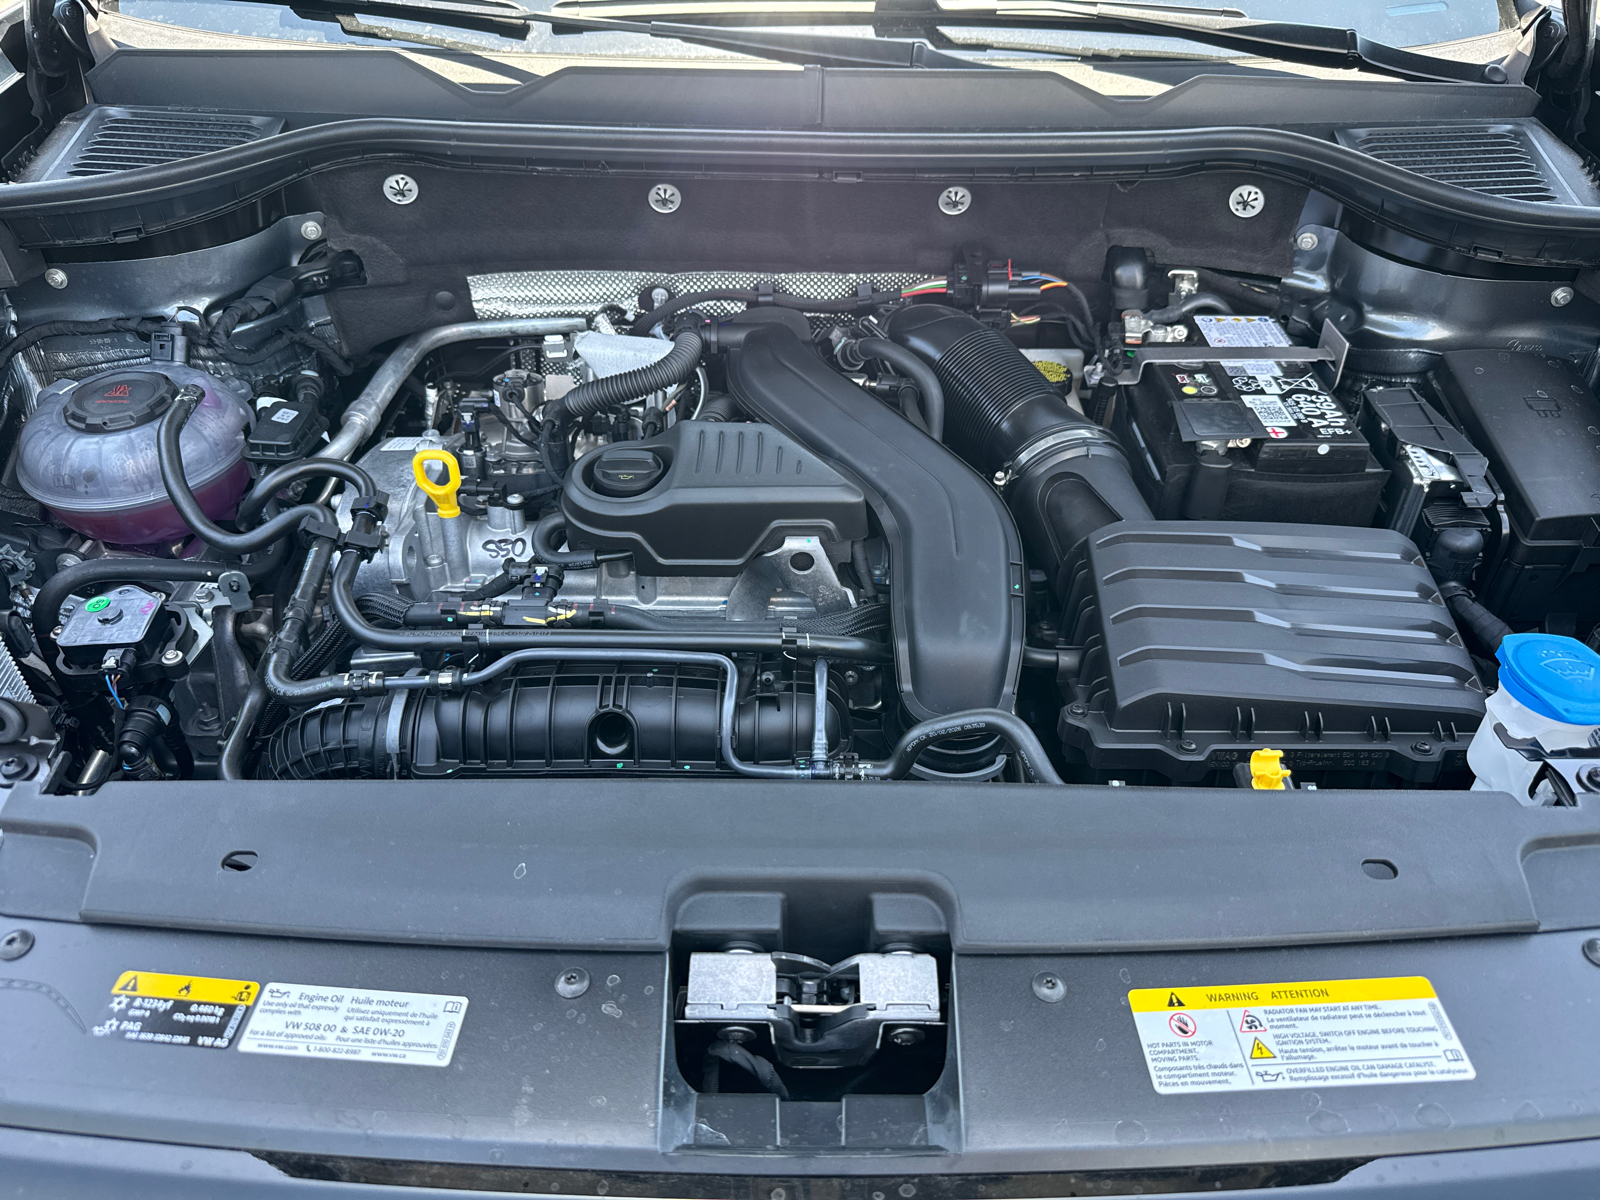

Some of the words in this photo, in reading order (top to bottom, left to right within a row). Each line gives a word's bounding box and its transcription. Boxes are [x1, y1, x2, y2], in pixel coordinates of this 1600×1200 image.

[1292, 394, 1321, 415] 640
[1307, 417, 1329, 427] A
[1311, 395, 1347, 426] 59Ah
[299, 992, 329, 1003] Engine
[331, 995, 344, 1003] Oil
[1206, 992, 1259, 1002] WARNING
[1271, 988, 1330, 1000] ATTENTION
[350, 996, 373, 1005] Huile
[375, 999, 409, 1007] moteur
[311, 1004, 340, 1012] expressly
[371, 1009, 409, 1018] uniquement
[120, 1020, 142, 1031] PAG
[381, 1017, 421, 1026] expressément
[285, 1020, 302, 1030] VW
[303, 1022, 322, 1031] 508
[323, 1024, 337, 1032] 00
[352, 1026, 371, 1035] SAE
[372, 1027, 405, 1037] 0W-20
[197, 1036, 213, 1046] VW
[213, 1037, 229, 1047] AG
[372, 1051, 406, 1059] www.vw.ca
